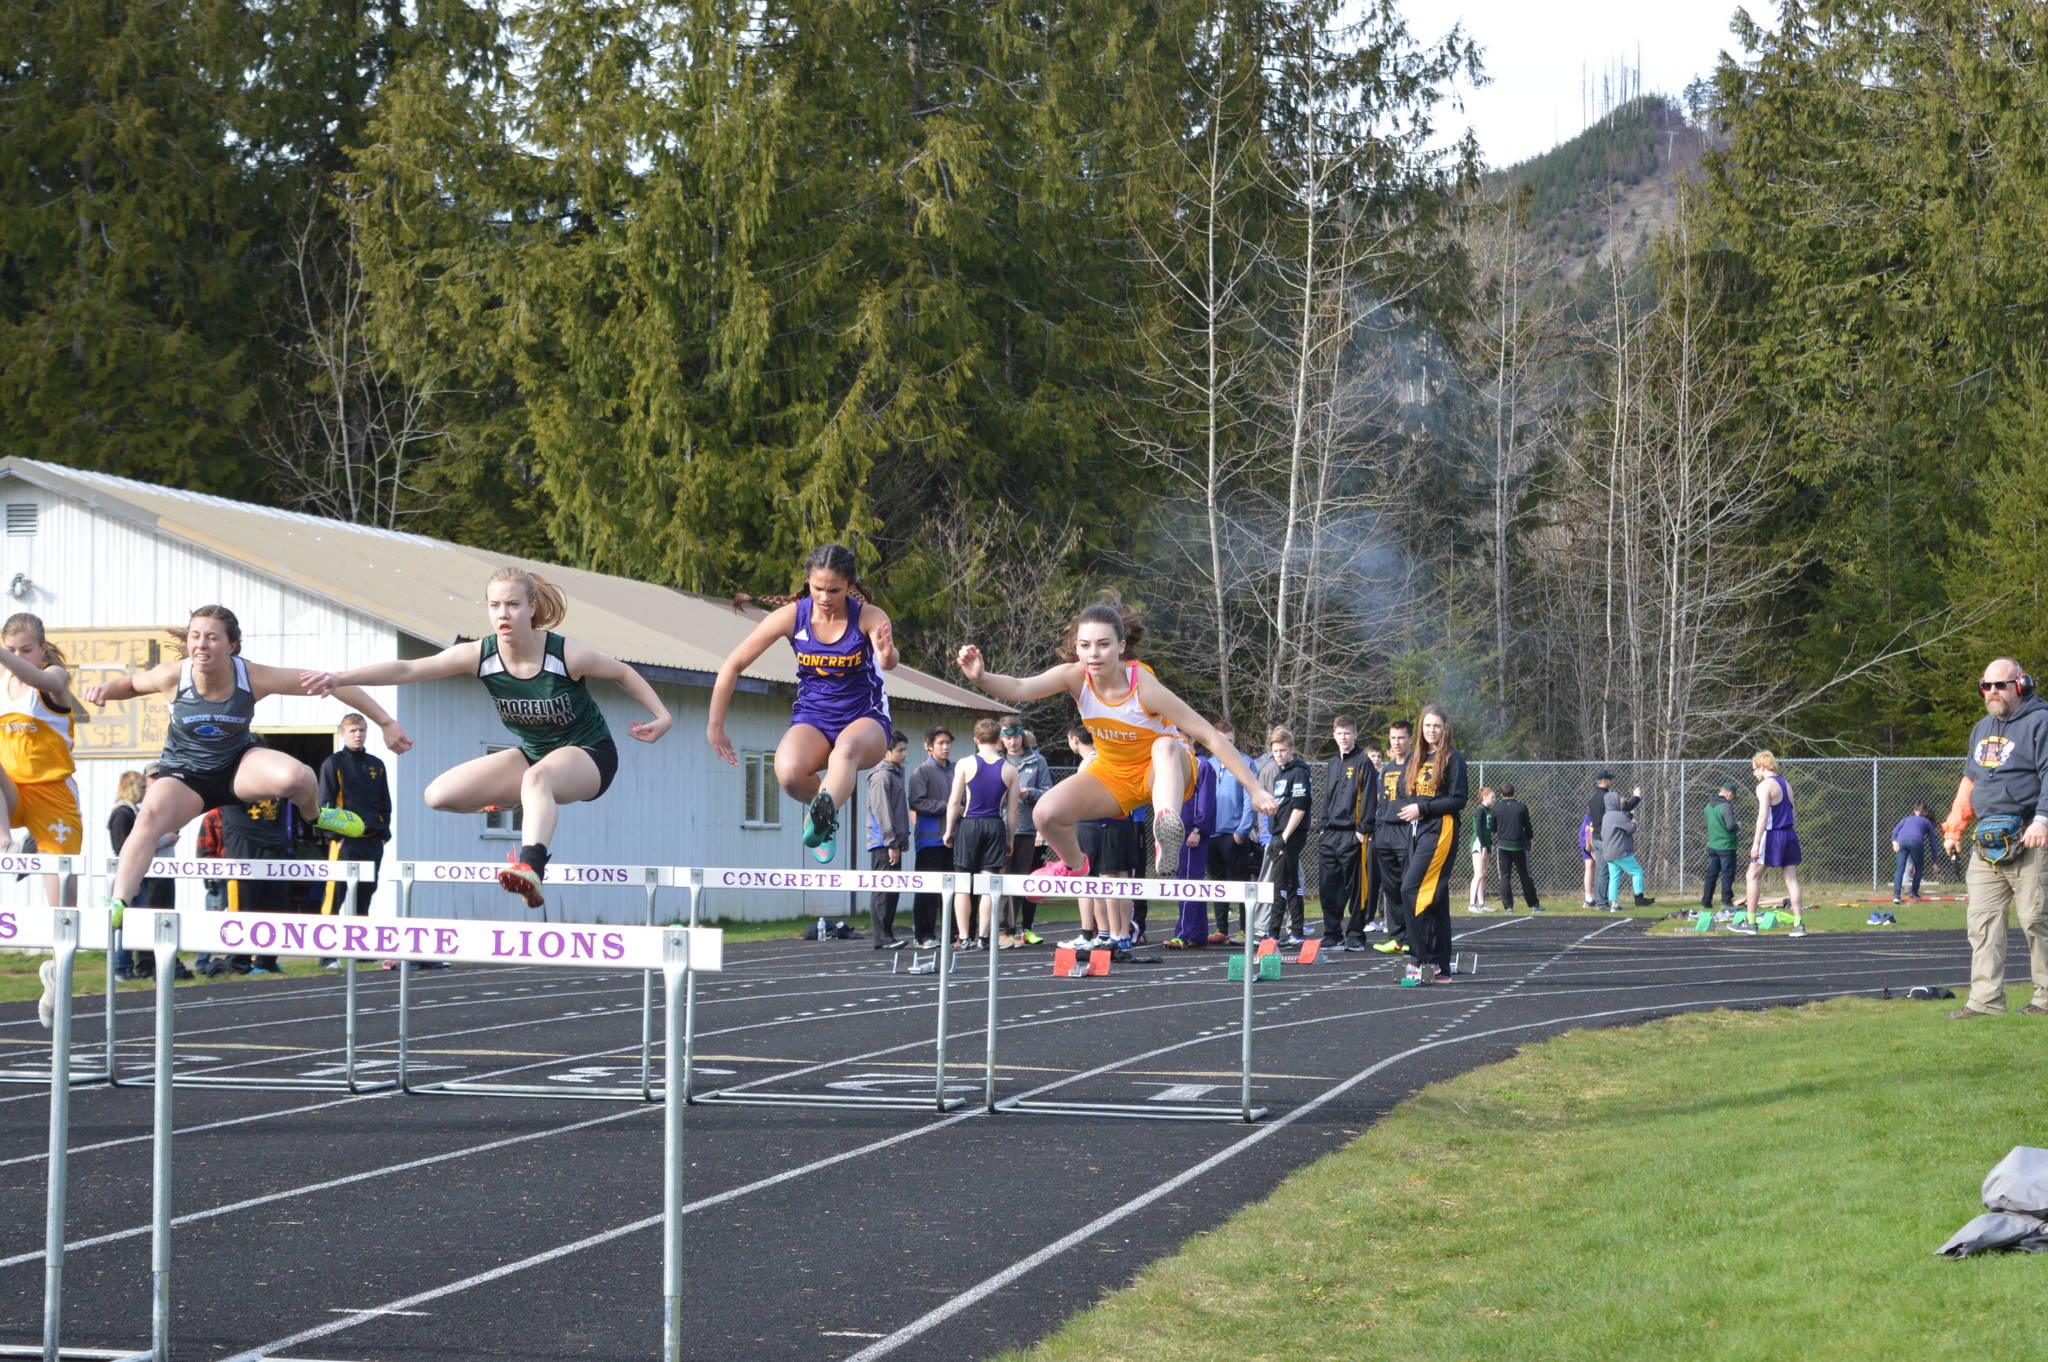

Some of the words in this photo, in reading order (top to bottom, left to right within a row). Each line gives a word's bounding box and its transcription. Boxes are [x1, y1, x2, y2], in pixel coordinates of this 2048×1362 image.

[797, 651, 862, 668] CONCRETE
[492, 692, 574, 717] HORELINE
[153, 862, 249, 876] ONCRETE
[266, 864, 328, 877] LIONS
[565, 868, 630, 883] LIONS
[723, 872, 839, 887] CONCRETE
[859, 875, 923, 888] LIONS
[1023, 880, 1141, 896] CONCRETE
[1159, 883, 1226, 898] LIONS
[220, 920, 459, 954] CONCRETE
[491, 930, 624, 960] LIONS
